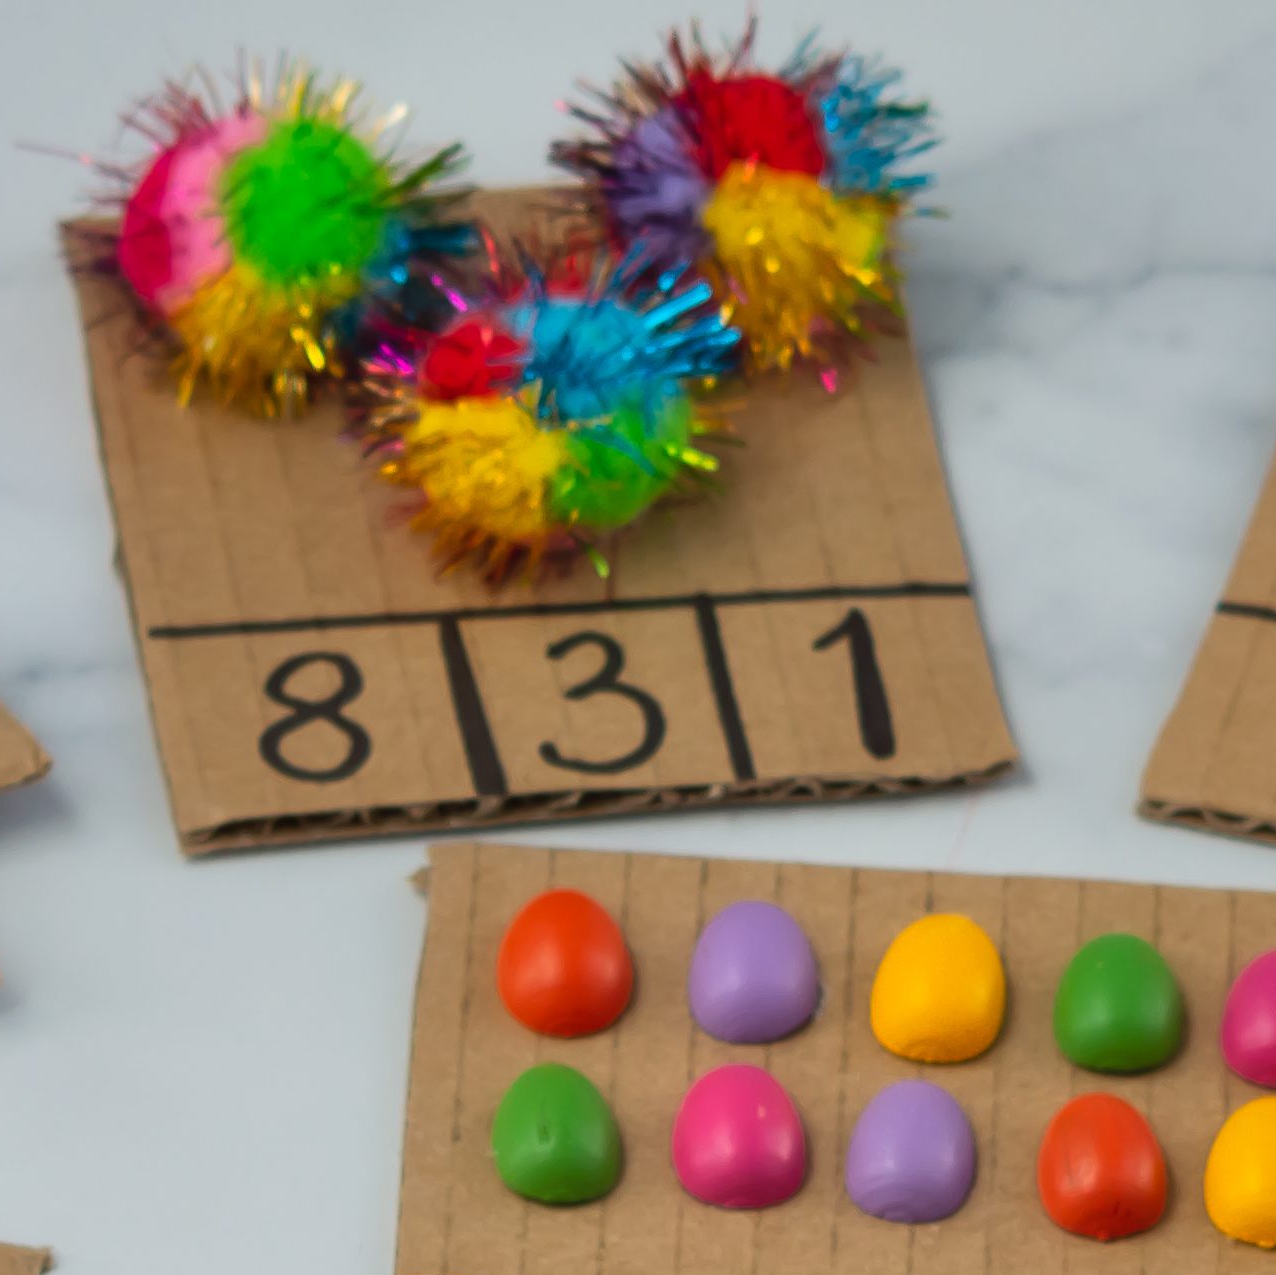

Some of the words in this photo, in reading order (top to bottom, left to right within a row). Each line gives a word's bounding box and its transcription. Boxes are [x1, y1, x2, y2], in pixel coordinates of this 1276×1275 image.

[259, 652, 371, 782] 8
[538, 631, 667, 773] 3
[812, 608, 897, 760] 1
